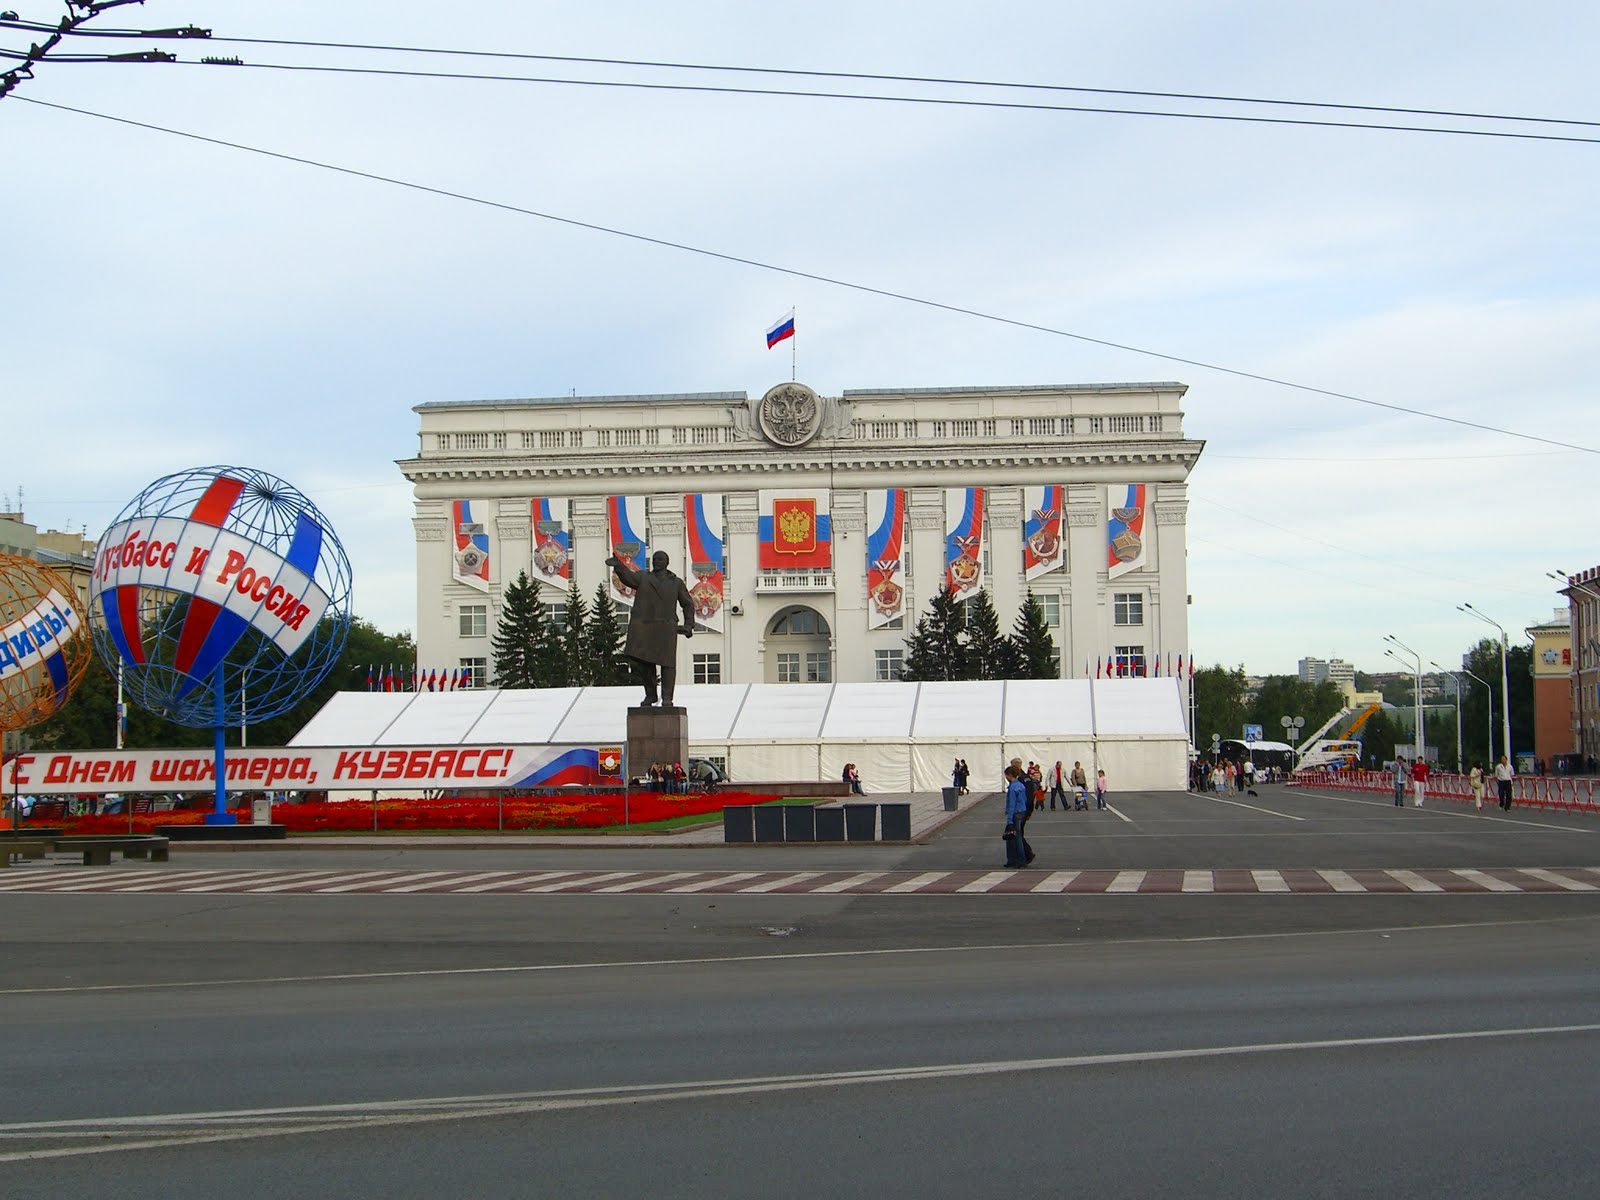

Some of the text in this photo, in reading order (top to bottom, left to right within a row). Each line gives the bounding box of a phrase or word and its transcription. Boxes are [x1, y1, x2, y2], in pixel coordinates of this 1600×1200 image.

[42, 754, 137, 783] Днем
[149, 756, 318, 787] шахтера,
[333, 748, 514, 781] КУЗБАСС!
